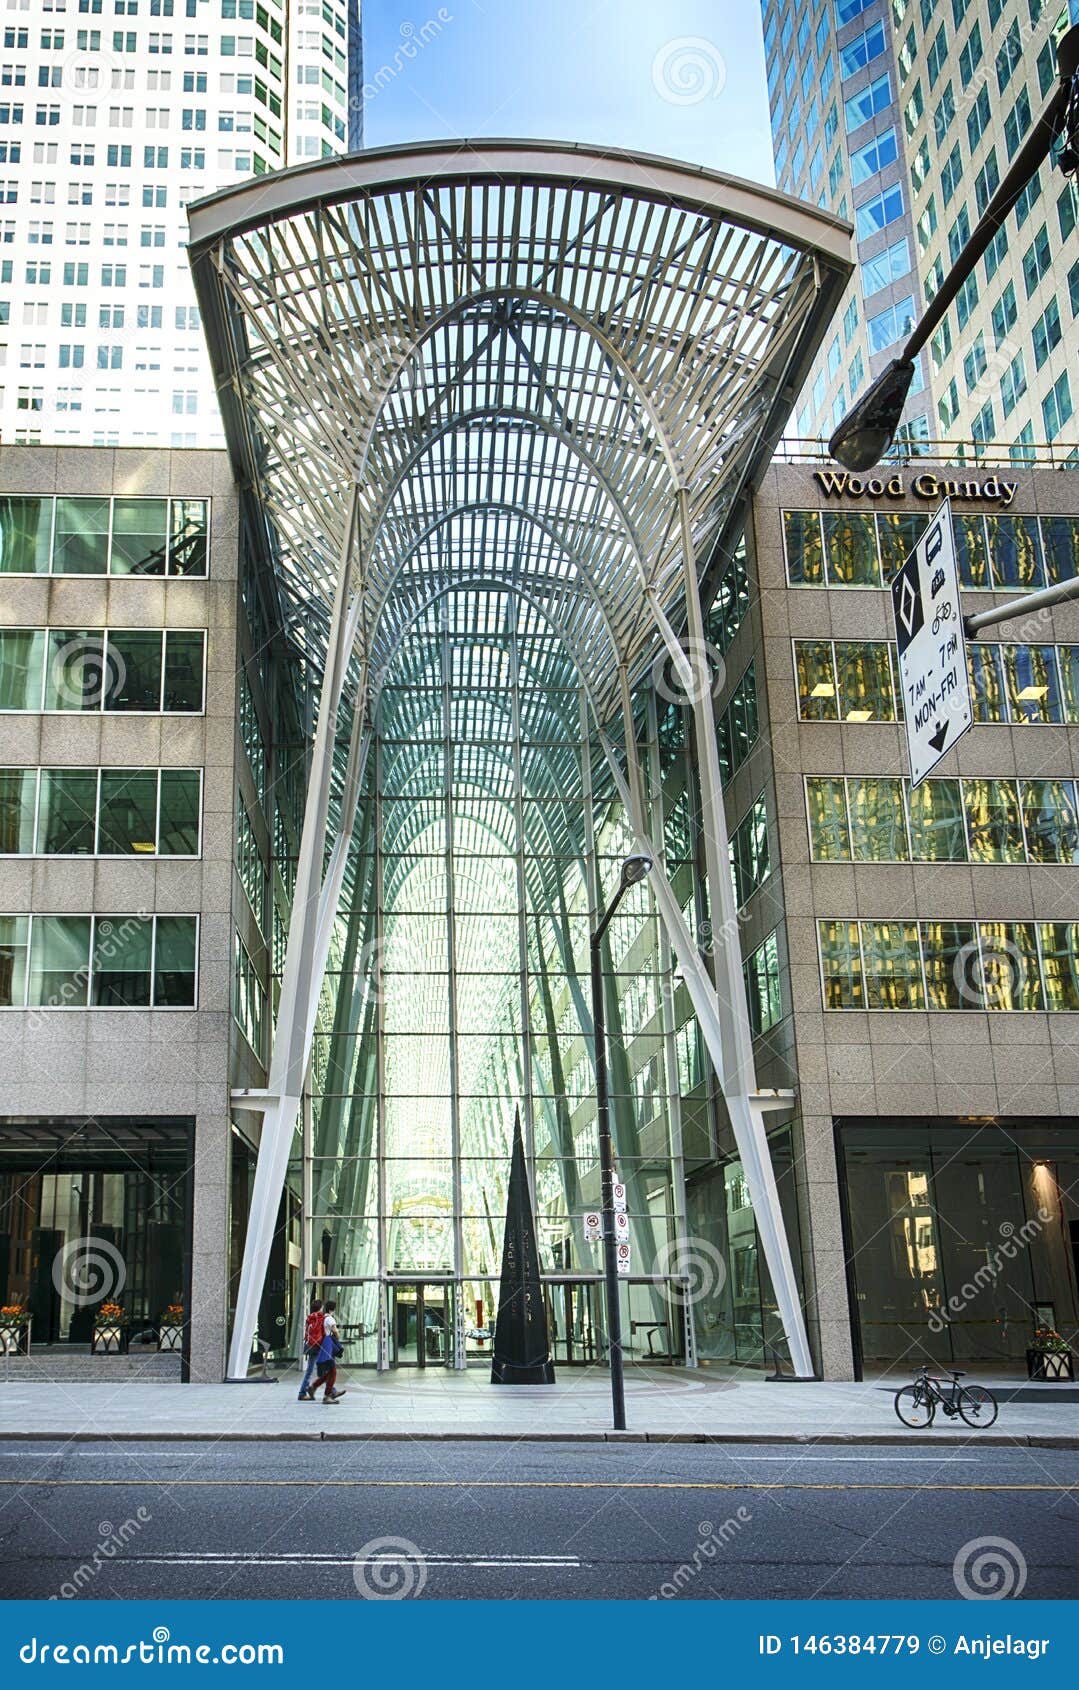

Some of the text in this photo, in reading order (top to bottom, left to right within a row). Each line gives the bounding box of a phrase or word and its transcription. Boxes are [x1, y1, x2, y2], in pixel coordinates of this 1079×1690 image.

[813, 471, 1018, 508] Wood Gundy
[914, 666, 958, 733] MON-FRI
